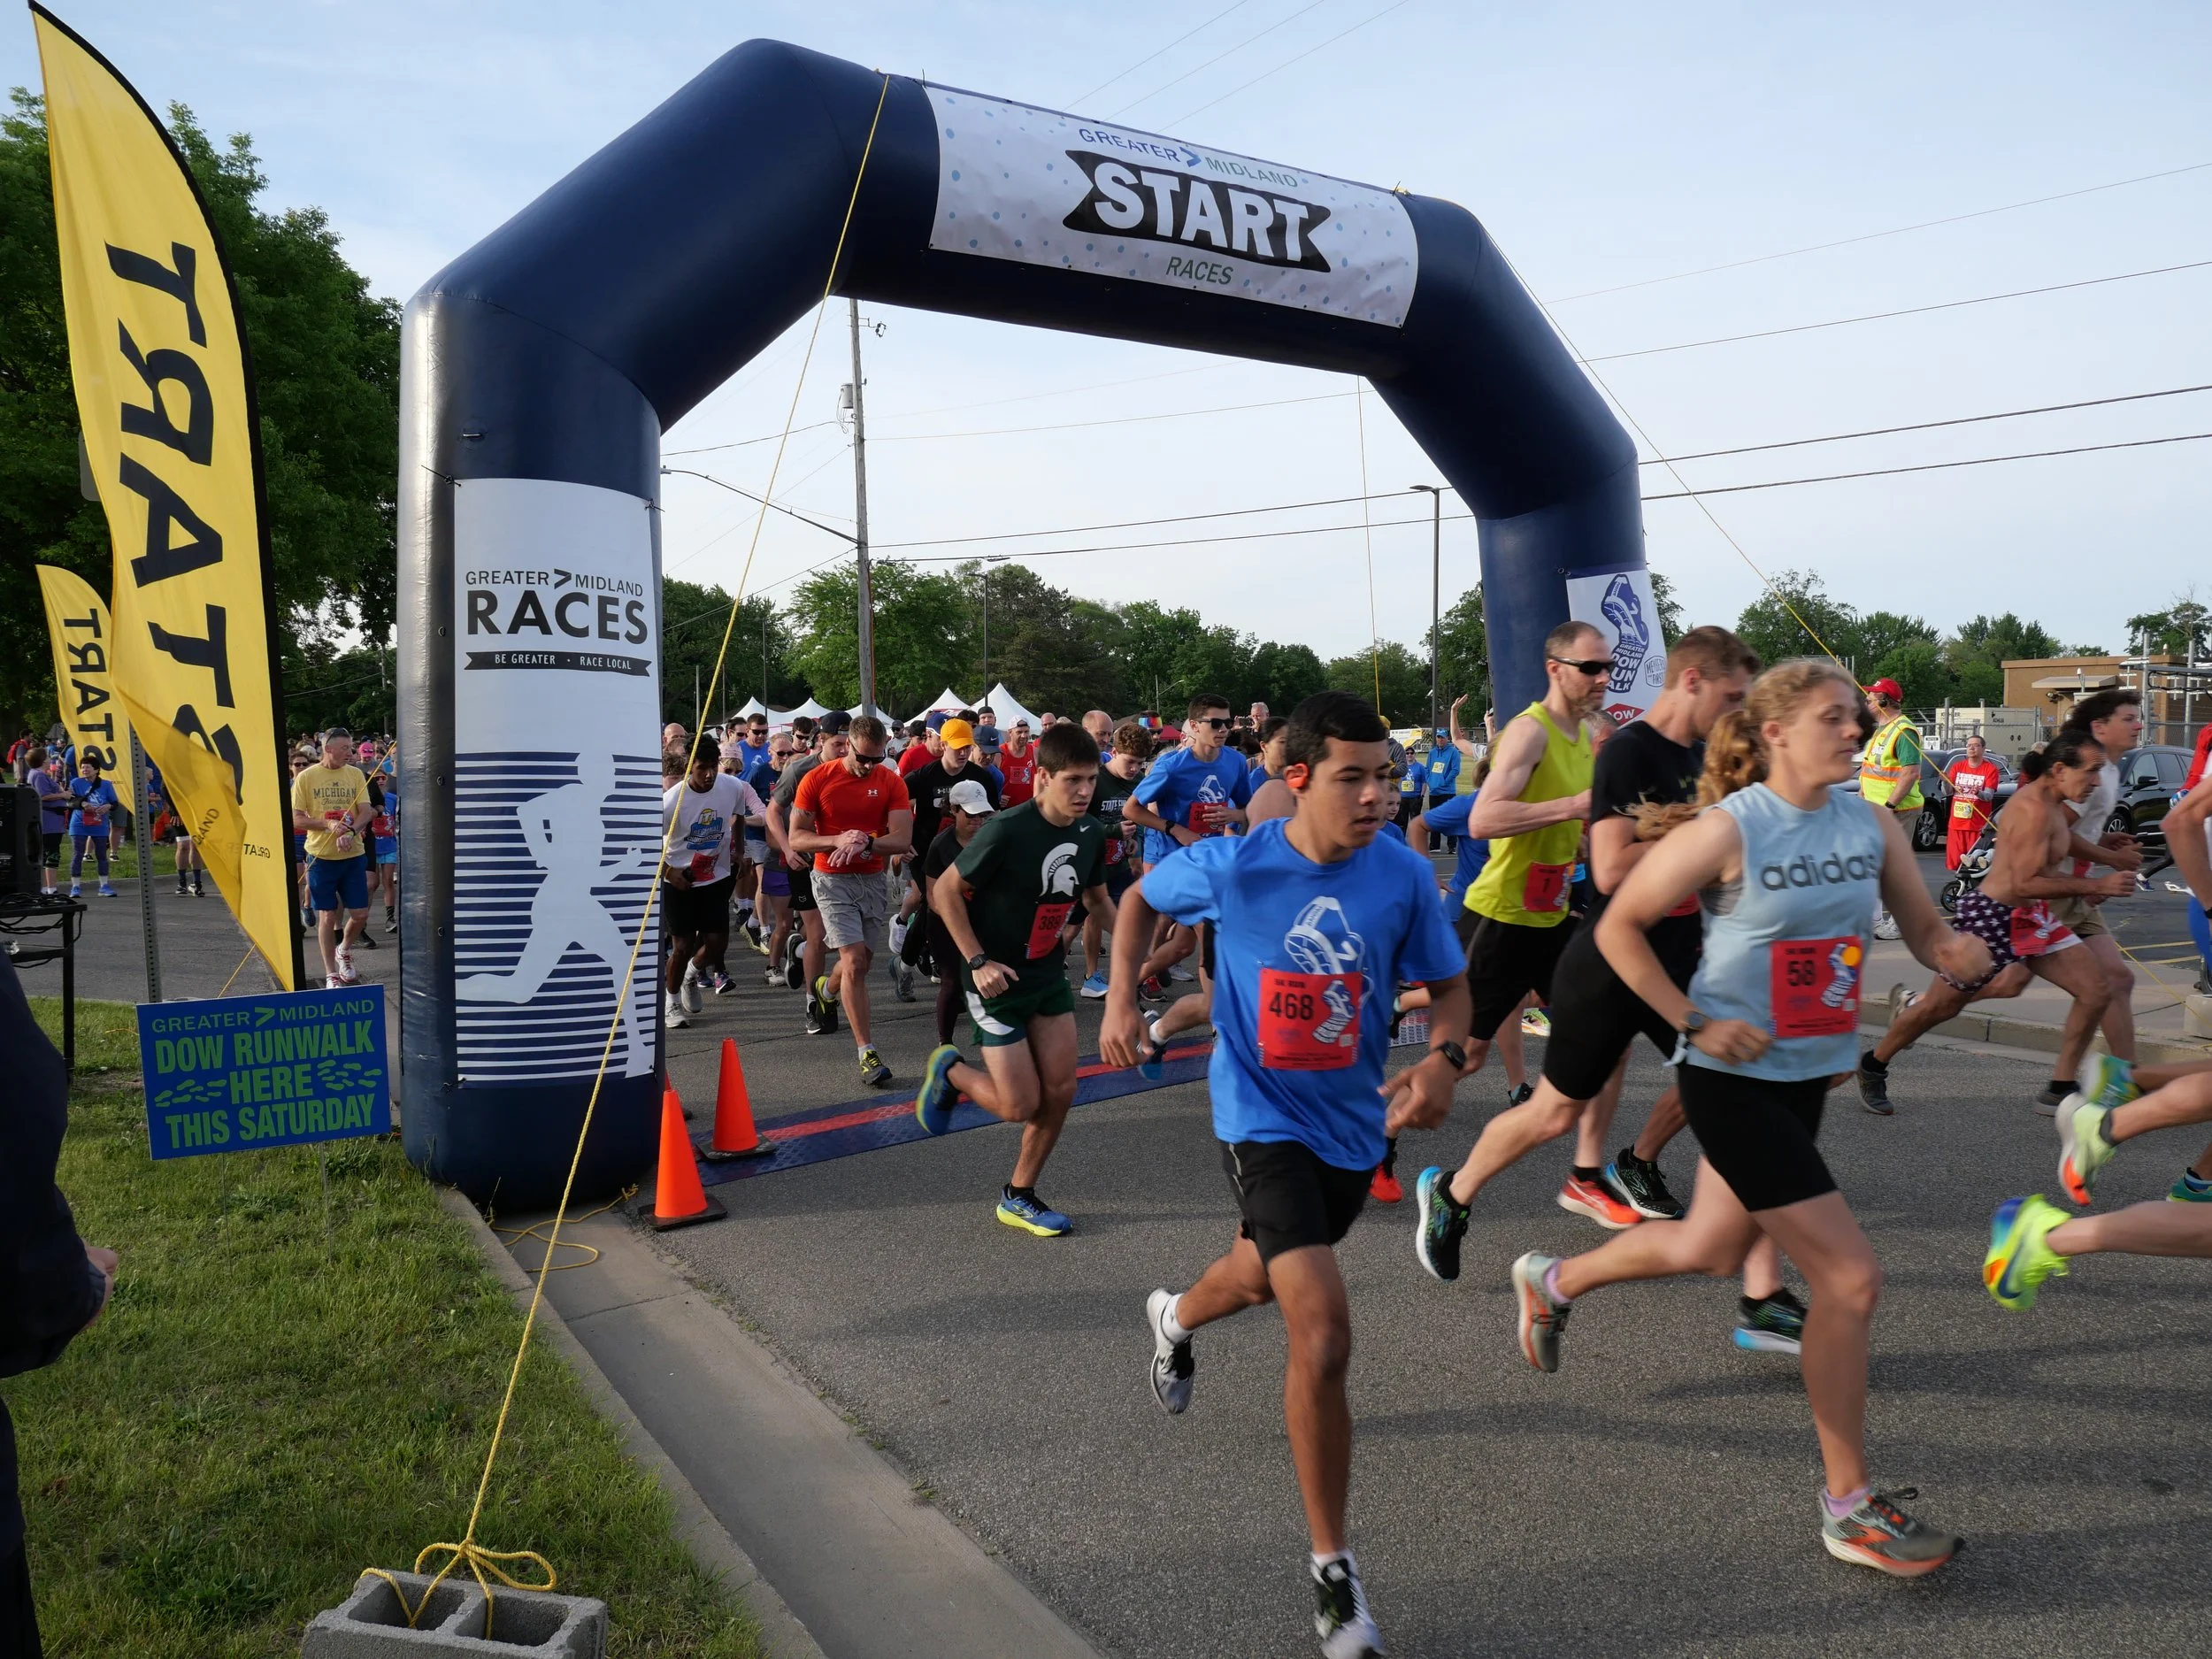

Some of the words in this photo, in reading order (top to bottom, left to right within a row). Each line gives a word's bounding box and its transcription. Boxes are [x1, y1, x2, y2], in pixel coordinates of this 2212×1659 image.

[1079, 127, 1181, 163] GREATER
[1204, 157, 1298, 188] MIDLAND
[1094, 162, 1308, 263] START
[1165, 257, 1233, 286] RACES
[465, 570, 549, 586] GREATER
[575, 574, 643, 597] MIDLAND
[466, 589, 649, 645] RACES
[495, 654, 506, 664] BE
[511, 654, 556, 664] GREATER
[580, 656, 603, 667] RACE
[607, 657, 632, 670] LOCAL
[1616, 648, 1643, 658] MIDLAND
[1620, 644, 1645, 653] GREATER
[1606, 680, 1631, 690] ALK
[1611, 667, 1635, 682] UN
[1610, 709, 1635, 720] OW
[313, 787, 357, 800] MICHIGAN
[1038, 915, 1062, 930] 389
[1788, 960, 1815, 987] 58
[151, 1011, 250, 1033] GREATER
[280, 999, 374, 1021] MIDLAND
[1269, 991, 1314, 1020] 468
[155, 1035, 223, 1074] DOW
[234, 1019, 374, 1066] RUNWALK
[229, 1064, 314, 1104] HERE
[165, 1110, 230, 1148] THIS
[238, 1093, 375, 1141] SATURDAY
